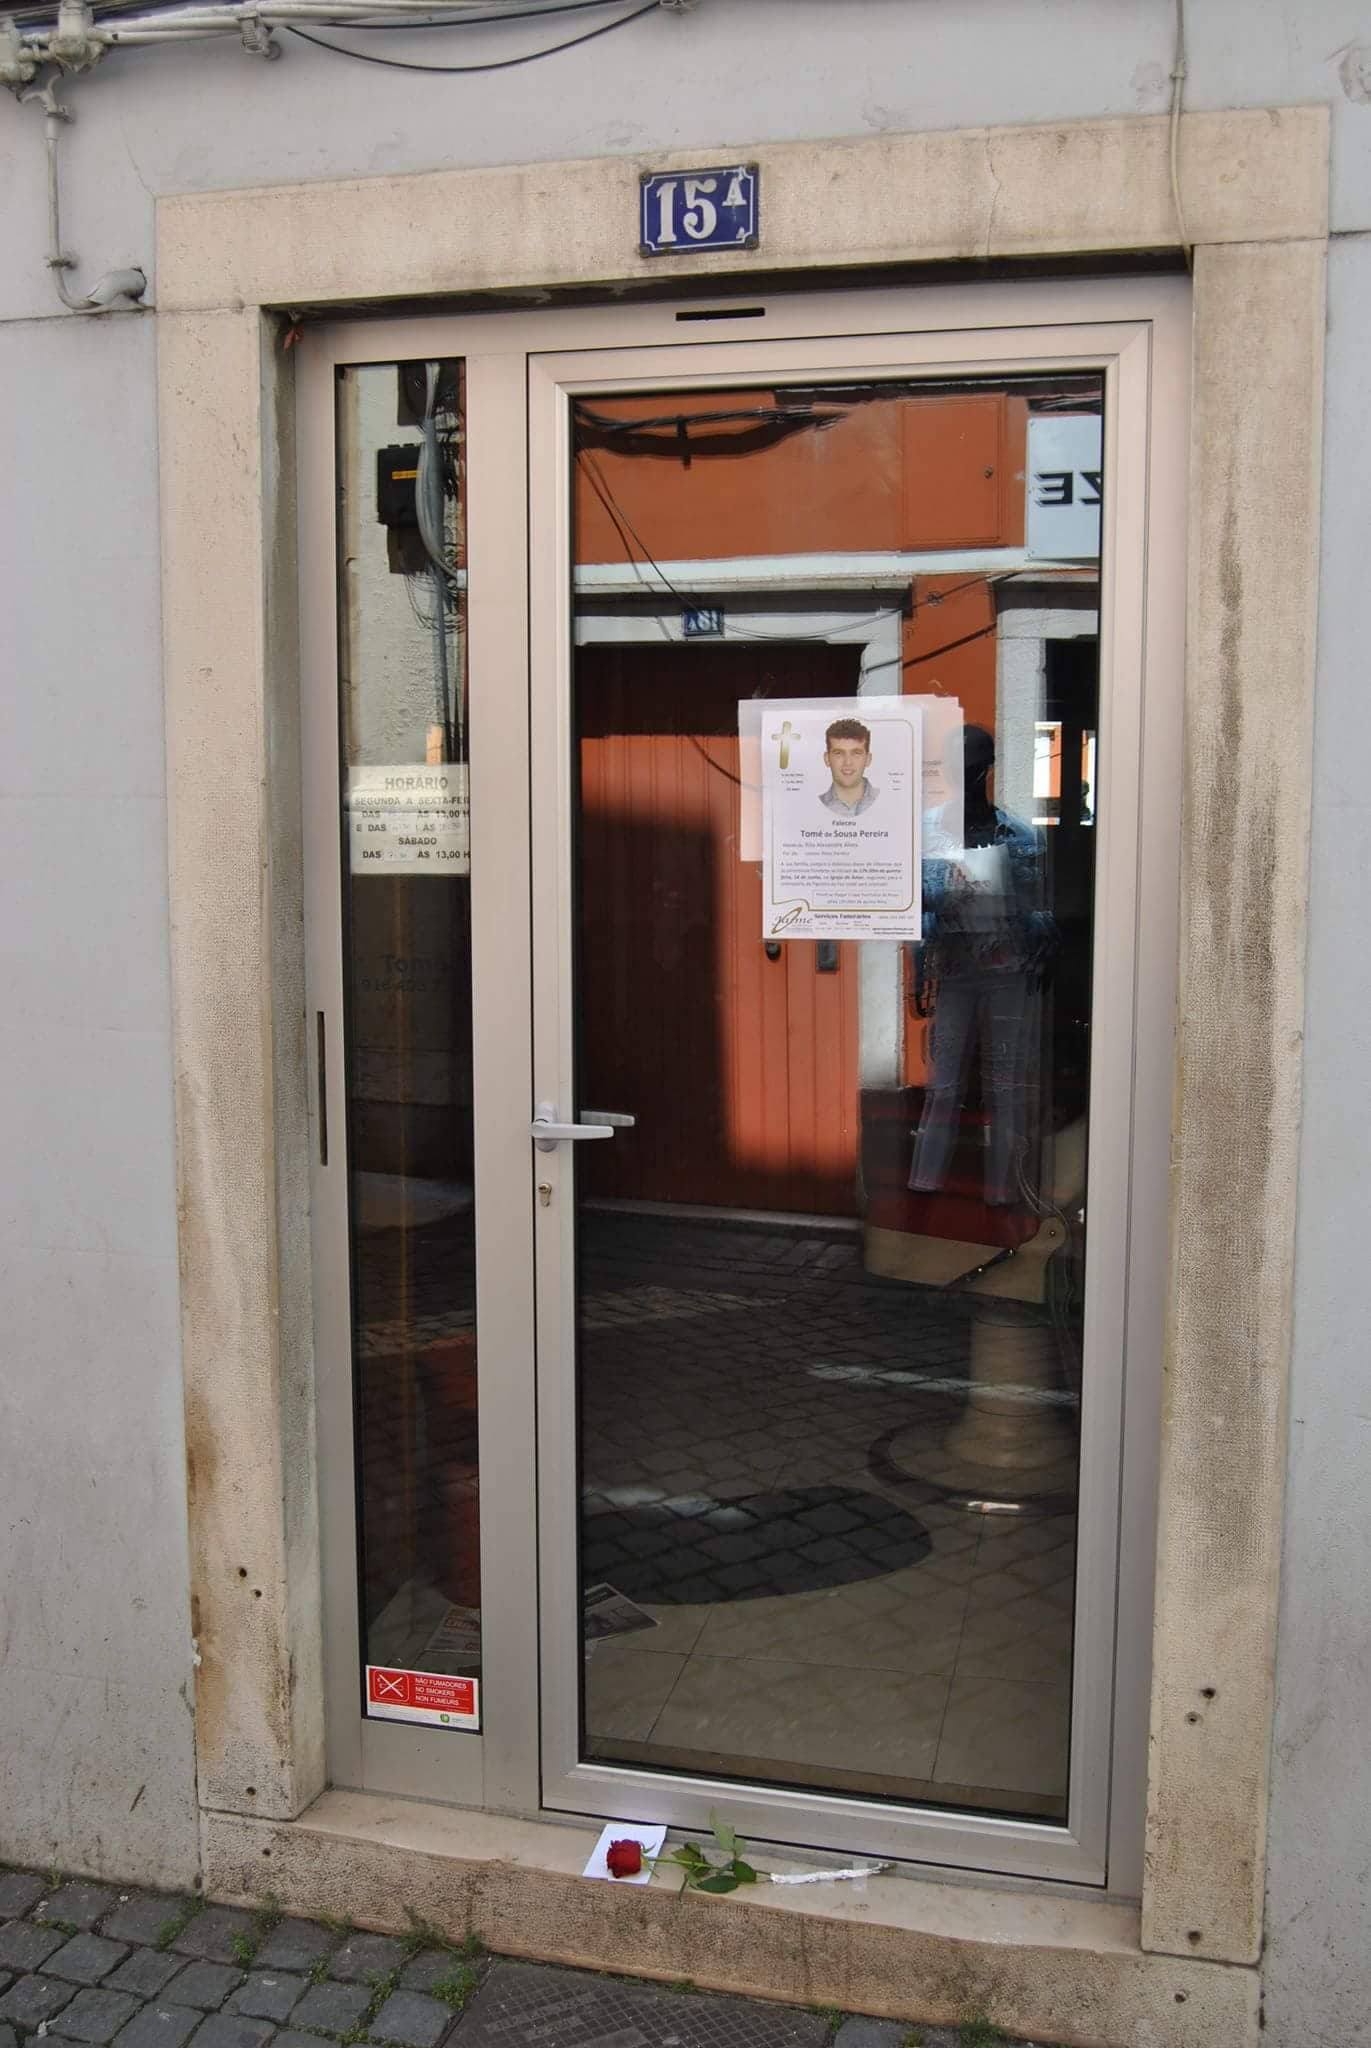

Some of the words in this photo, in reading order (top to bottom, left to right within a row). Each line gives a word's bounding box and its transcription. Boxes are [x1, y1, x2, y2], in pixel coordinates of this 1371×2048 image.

[355, 796, 401, 806] SEGUNDA
[356, 824, 362, 832] E
[368, 824, 387, 832] DAS
[800, 829, 823, 838] Tomé
[833, 829, 858, 838] Sousa
[860, 829, 889, 838] Pereira
[362, 851, 382, 859] DAS
[436, 851, 461, 860] 13,00
[416, 1677, 429, 1685] NÃO
[430, 1679, 467, 1690] FUMADORES
[426, 1687, 456, 1697] SMOKERS
[416, 1695, 429, 1703] NON
[430, 1696, 460, 1706] FUMEURS
